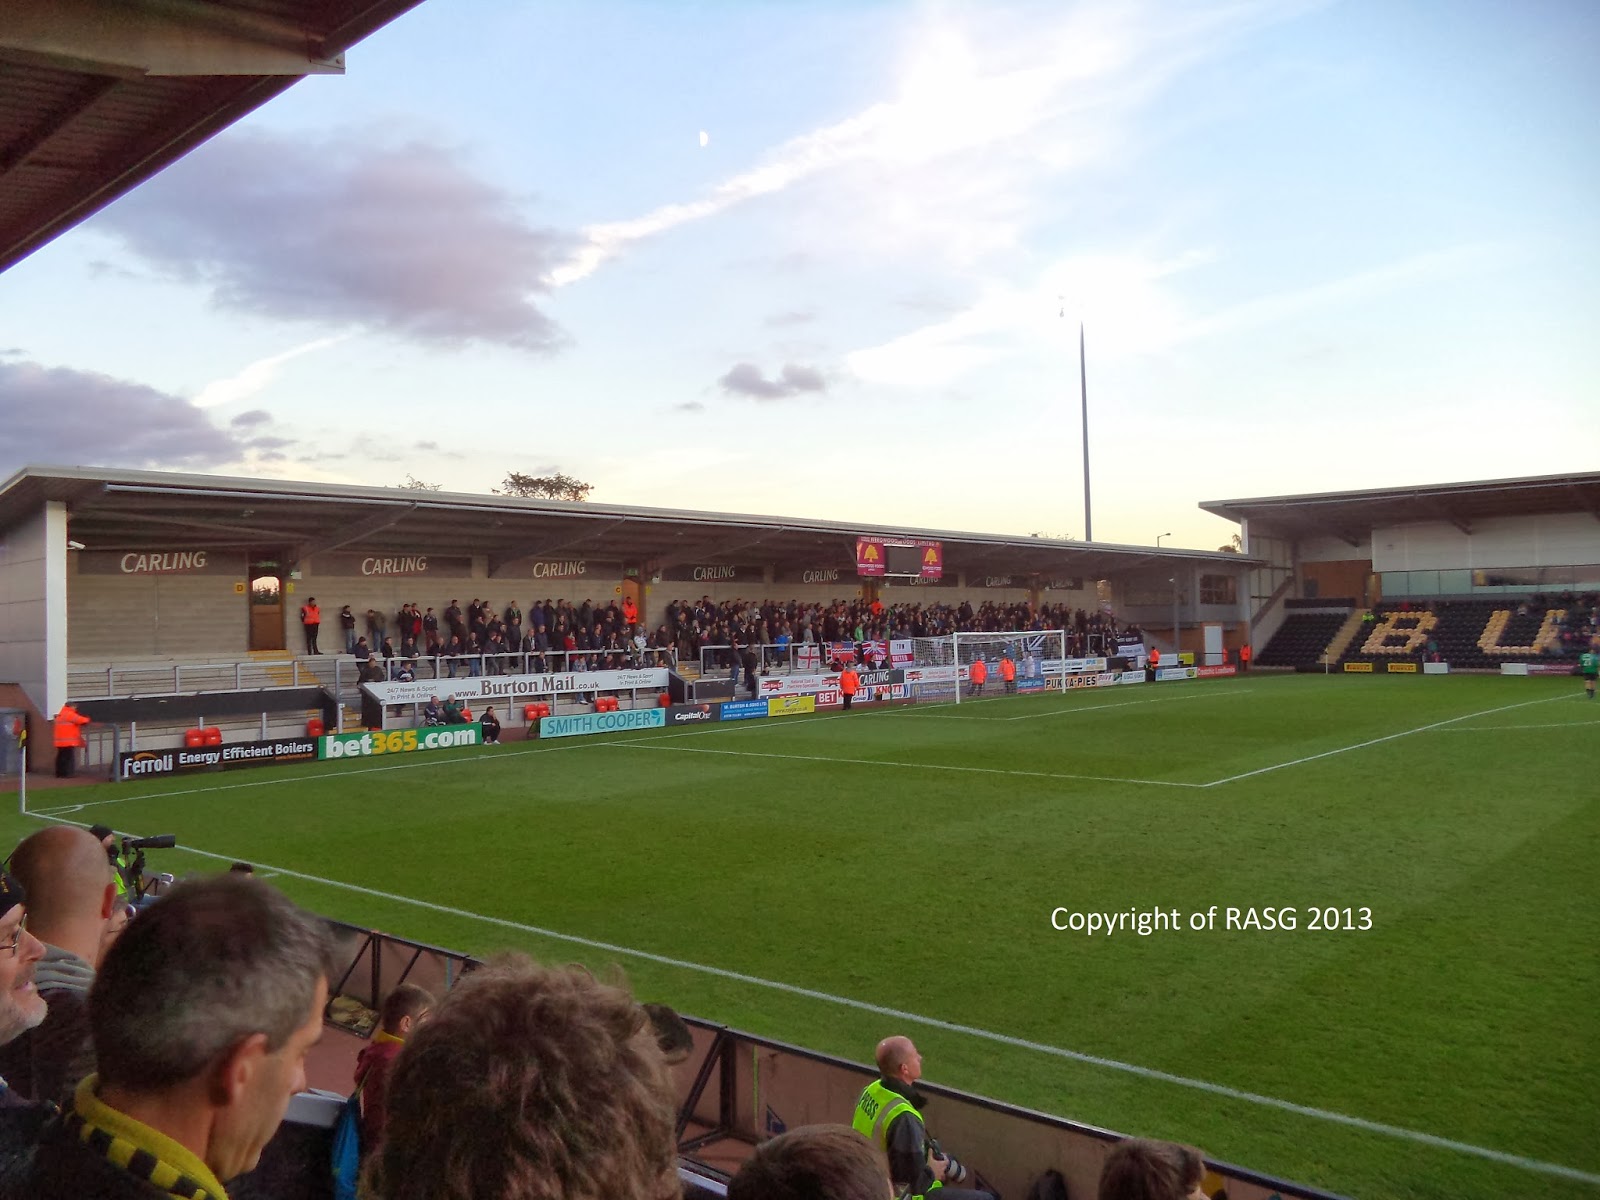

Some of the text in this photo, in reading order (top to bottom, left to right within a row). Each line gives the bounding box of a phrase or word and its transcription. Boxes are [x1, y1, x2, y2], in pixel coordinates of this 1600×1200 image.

[120, 551, 207, 573] CARLING
[361, 556, 427, 575] CARLING
[533, 561, 586, 578] CARLING
[693, 565, 735, 581] CARLING
[802, 569, 838, 583] CARLING
[985, 575, 1011, 587] CARLING
[859, 670, 889, 686] CARLING
[819, 692, 835, 703] BET
[547, 712, 651, 735] SMITH COOPER
[325, 729, 476, 758] bet365.com
[179, 751, 220, 765] Energy
[222, 745, 274, 760] Efficient
[275, 742, 314, 756] Boilers
